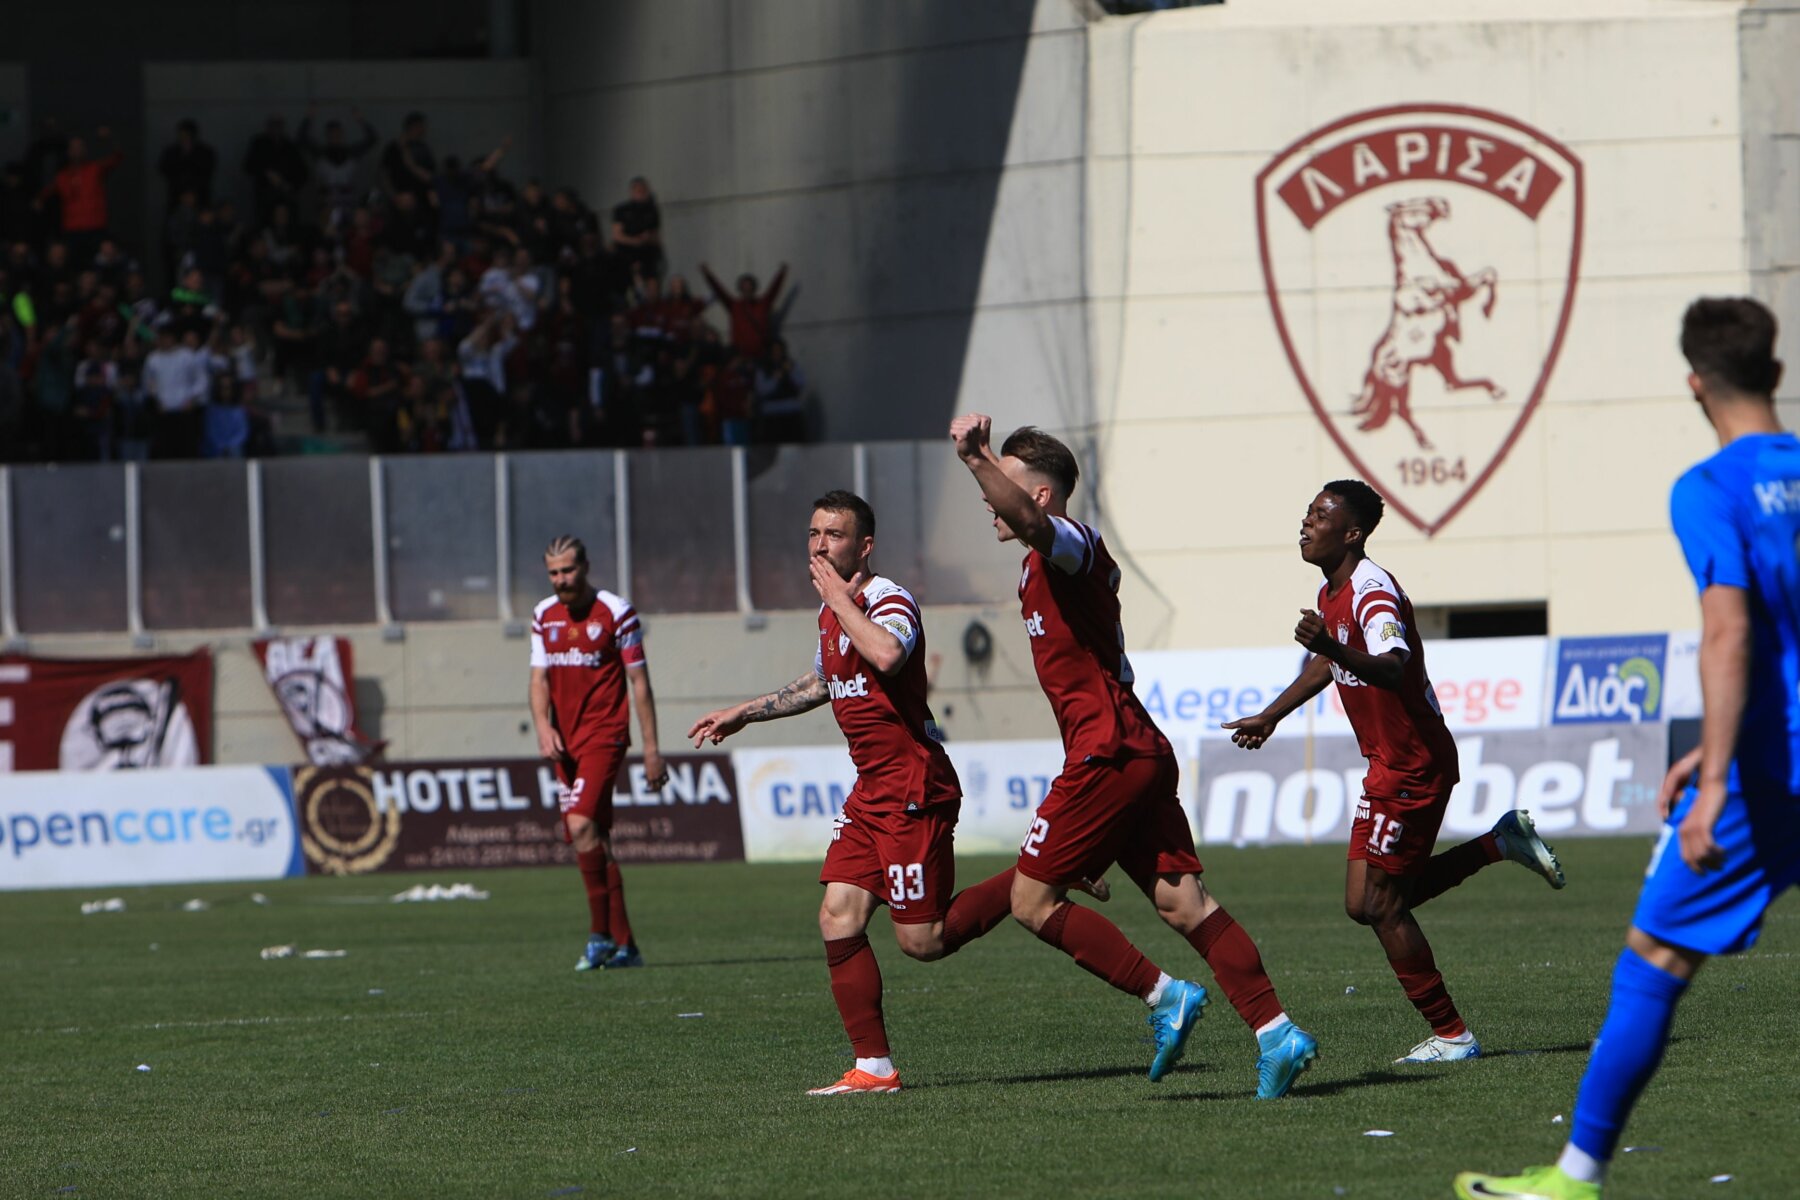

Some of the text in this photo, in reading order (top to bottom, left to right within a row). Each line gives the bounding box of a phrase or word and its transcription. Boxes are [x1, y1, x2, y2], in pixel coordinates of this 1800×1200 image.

[1300, 132, 1537, 211] ΛΑΡΙΣΑ
[1396, 457, 1468, 486] 1964
[372, 761, 731, 813] HOTEL HLENA
[0, 805, 280, 859] pencare.gr
[1368, 812, 1404, 854] 12
[888, 862, 925, 902] 33
